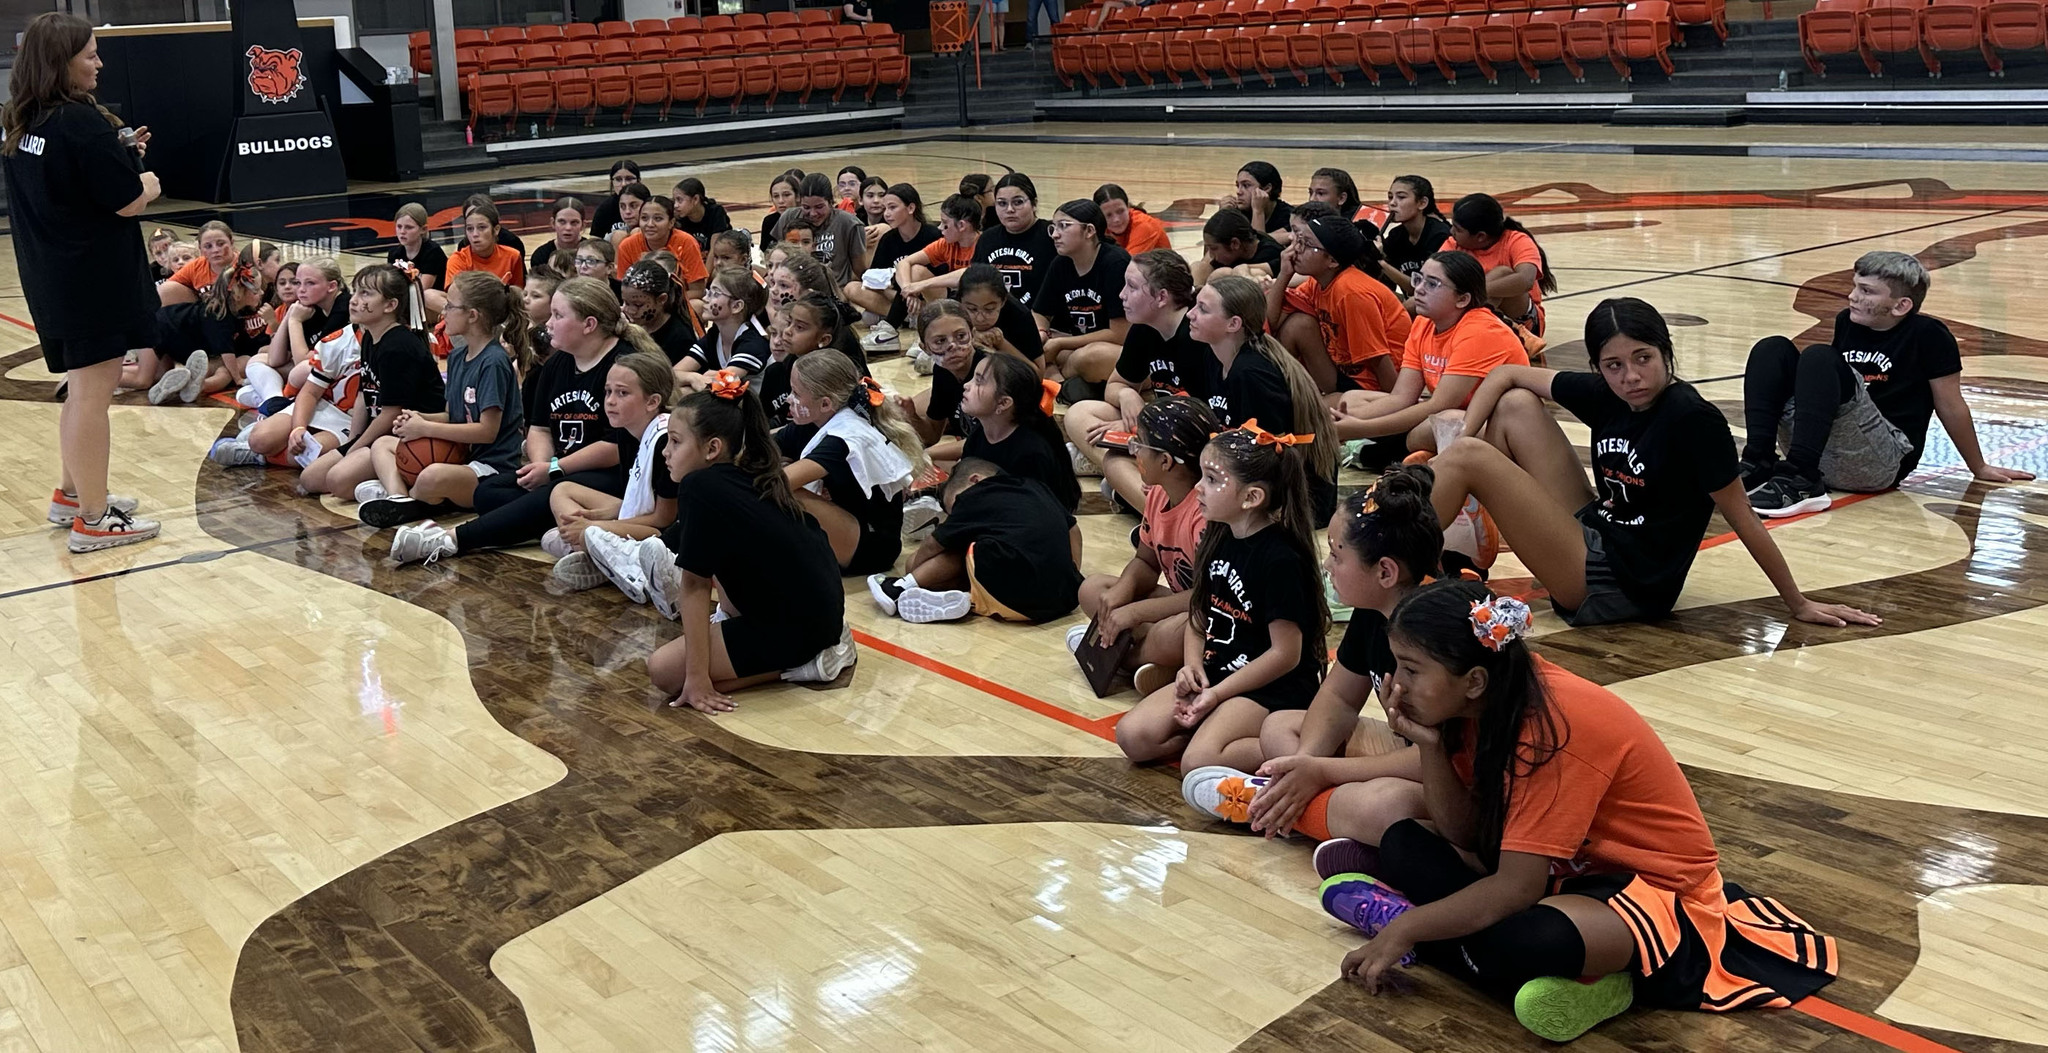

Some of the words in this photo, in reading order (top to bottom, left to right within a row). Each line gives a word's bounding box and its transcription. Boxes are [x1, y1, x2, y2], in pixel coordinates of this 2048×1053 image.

[238, 135, 333, 156] BULLDOGS
[988, 247, 1014, 264] ARTESIA
[1227, 568, 1253, 613] GIRLS
